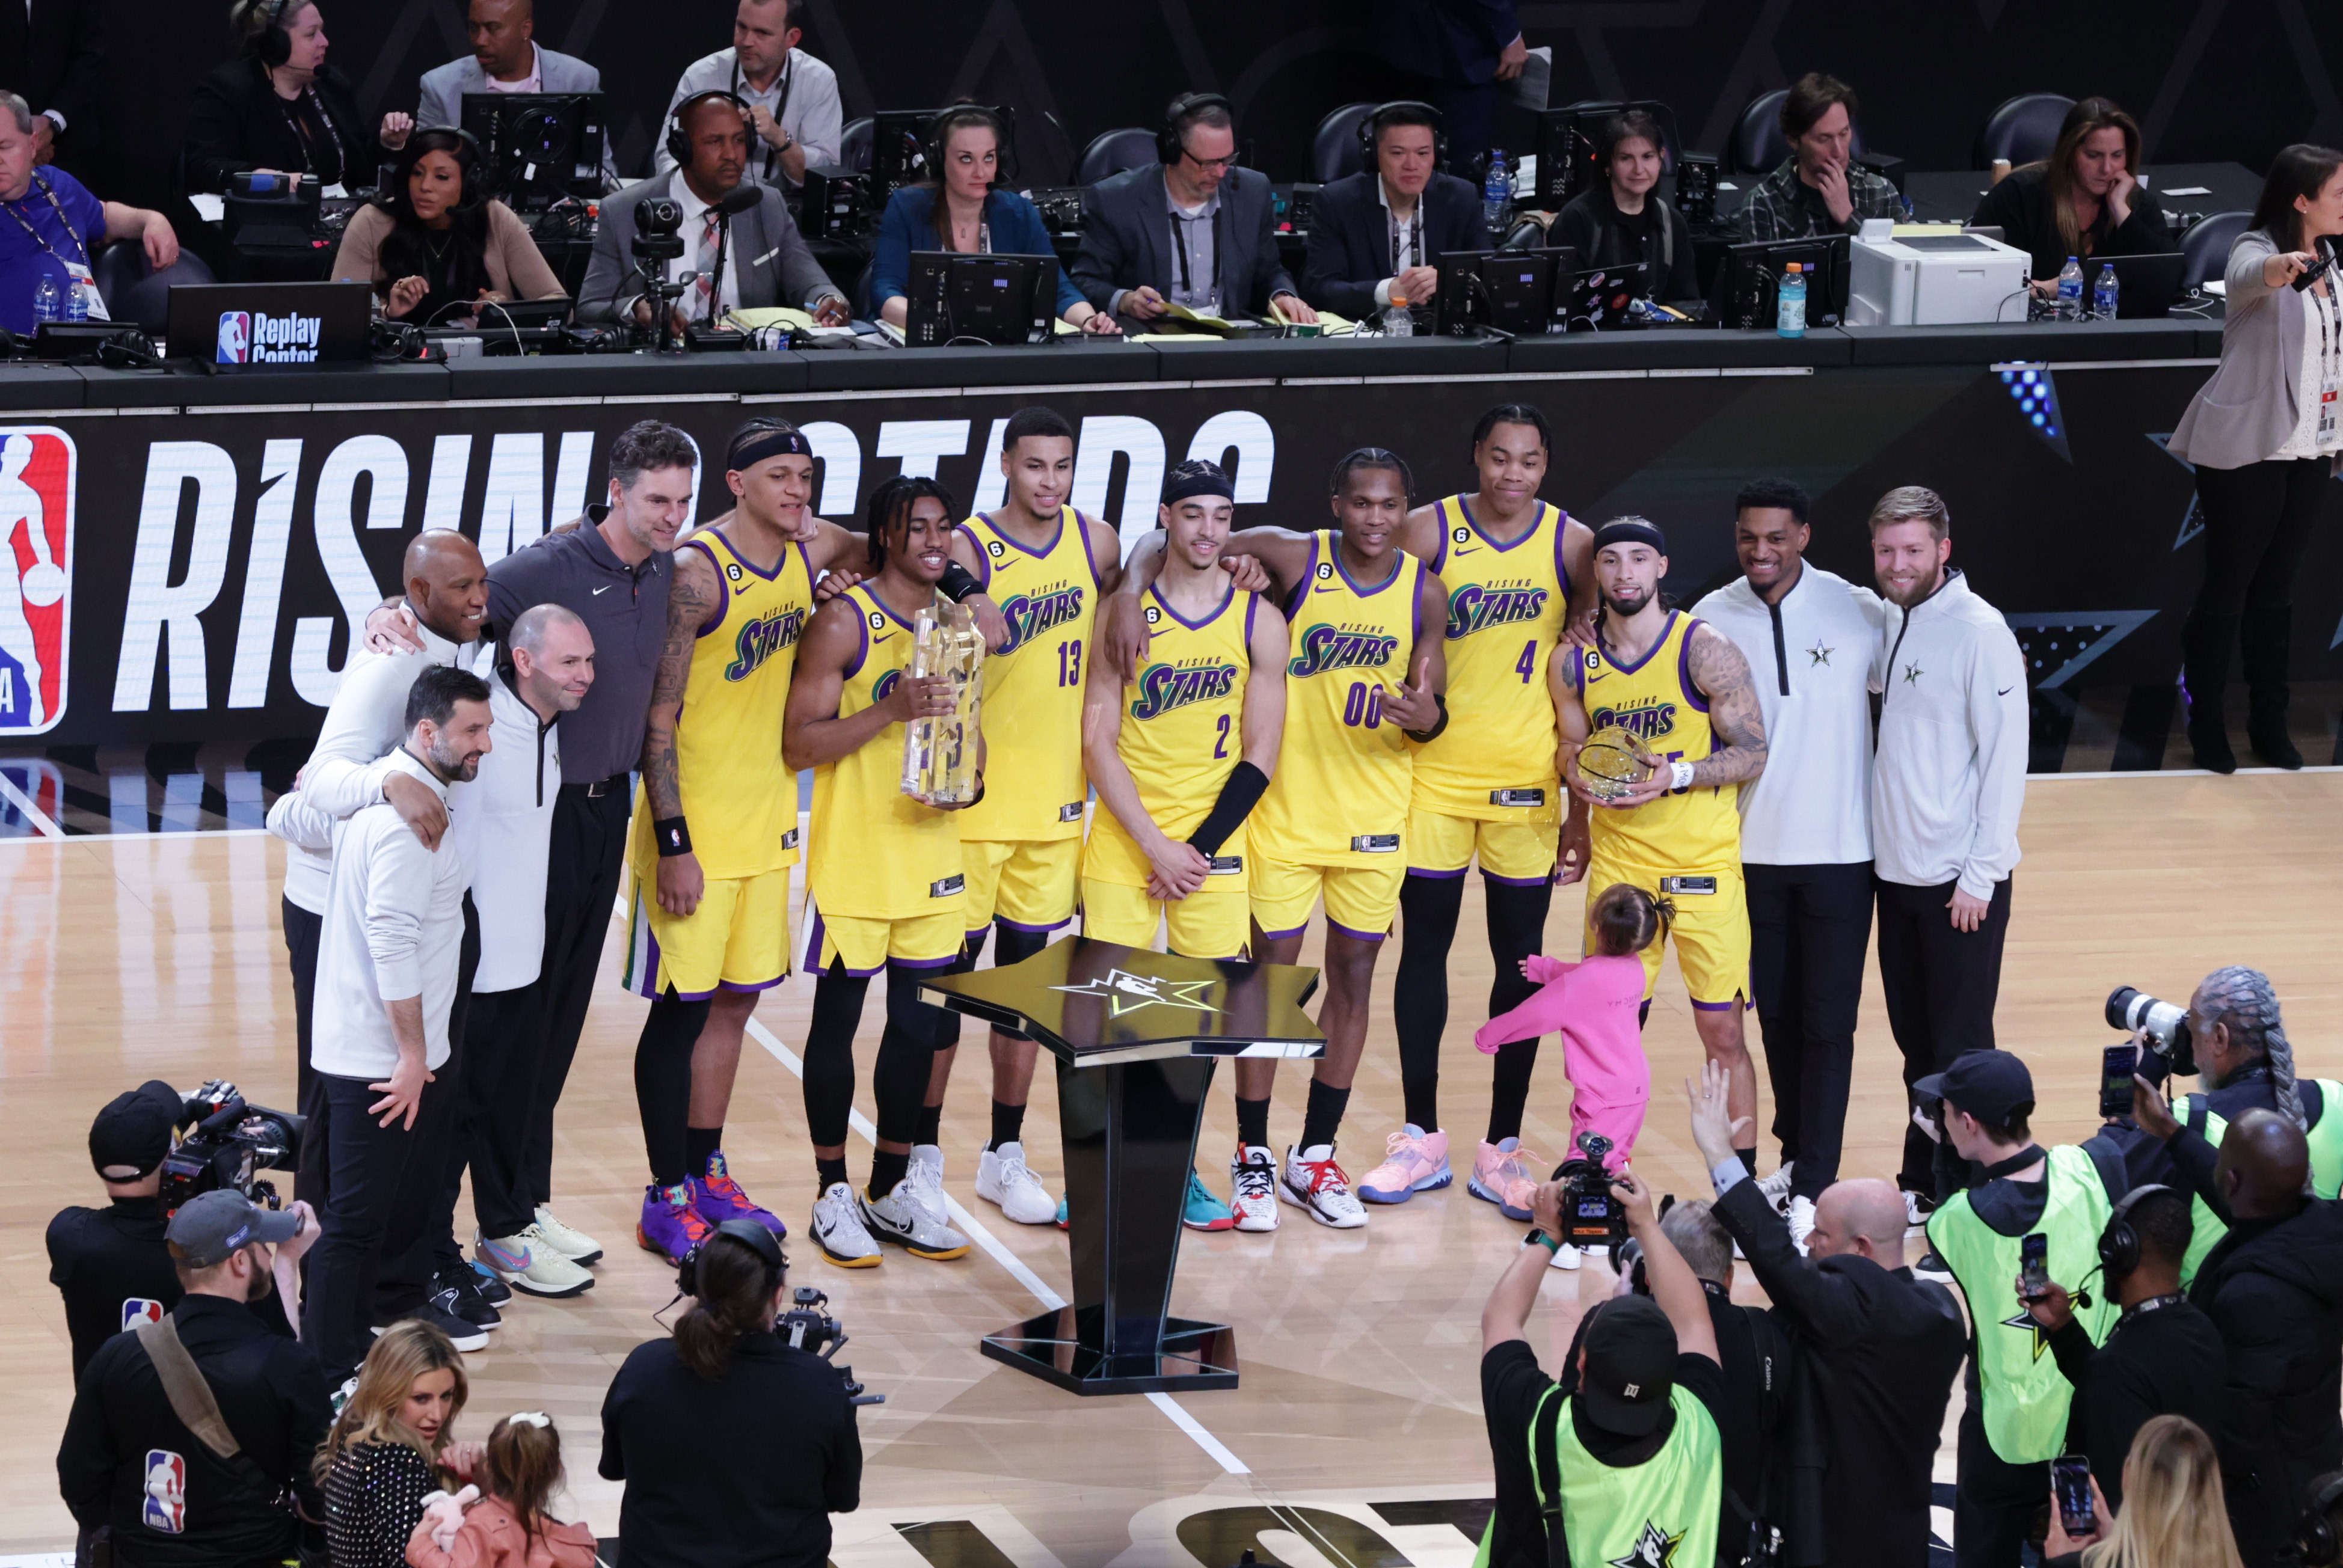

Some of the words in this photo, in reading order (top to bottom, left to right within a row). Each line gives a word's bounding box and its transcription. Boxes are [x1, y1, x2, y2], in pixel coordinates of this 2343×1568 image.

[253, 312, 321, 349] Replay
[1456, 529, 1467, 542] 6
[990, 543, 1002, 556] 6
[728, 565, 740, 580] 6
[1319, 565, 1330, 578] 6
[1031, 579, 1067, 597] RISING
[1486, 578, 1532, 589] RISING
[763, 601, 794, 620] RISING
[1146, 608, 1158, 622] 6
[1445, 583, 1549, 640] STARS
[871, 614, 882, 628] 6
[992, 586, 1084, 656] STARS
[1340, 623, 1384, 634] RISING
[725, 607, 806, 682] STARS
[1288, 623, 1399, 678] STARS
[1058, 639, 1082, 687] 13
[1177, 656, 1221, 668] RISING
[1515, 640, 1538, 684] 4
[1588, 653, 1598, 667] 6
[1131, 663, 1238, 721] STARS
[1343, 681, 1384, 729] 00
[1617, 696, 1657, 711] RISING
[1214, 714, 1230, 759] 2
[149, 1513, 168, 1529] NBA
